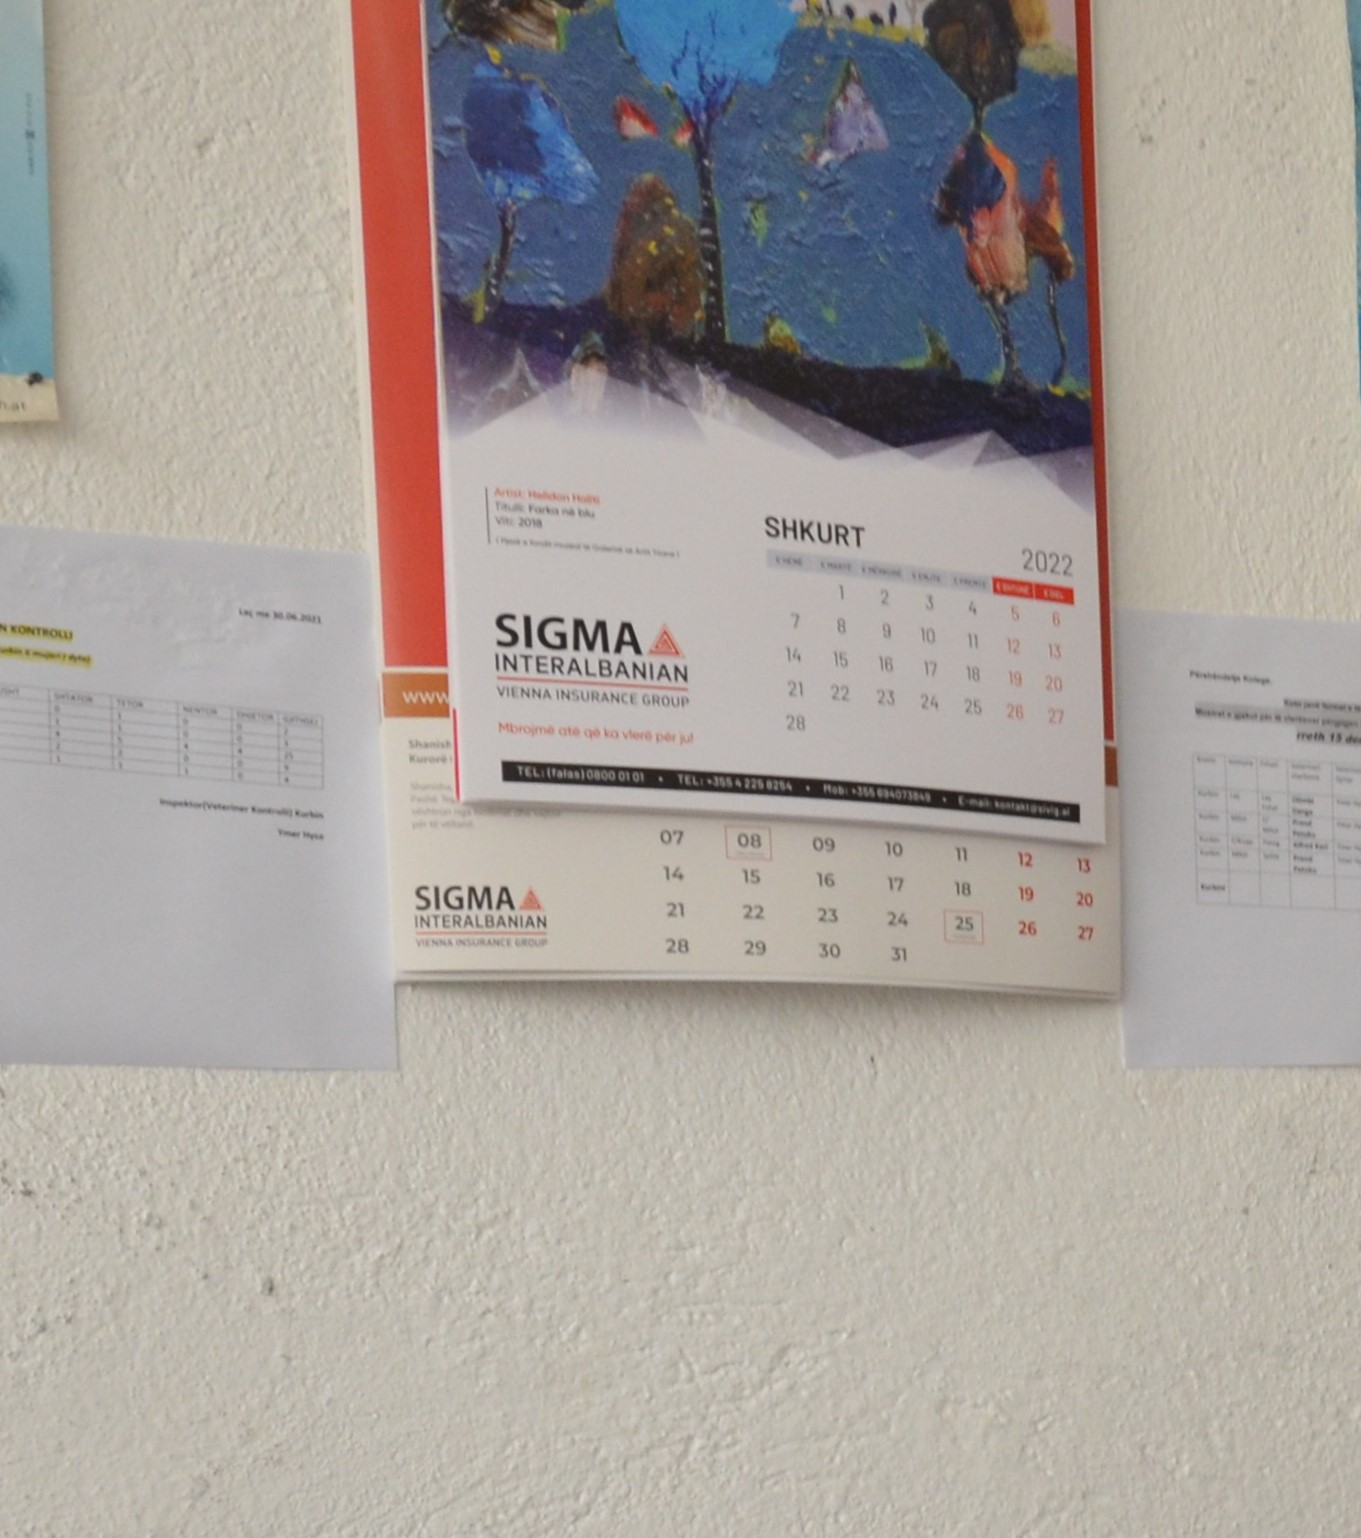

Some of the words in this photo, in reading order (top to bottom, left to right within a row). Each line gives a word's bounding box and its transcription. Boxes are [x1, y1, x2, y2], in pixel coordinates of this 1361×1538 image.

[518, 517, 543, 528] 2018
[765, 516, 865, 548] SHKURT
[1022, 548, 1073, 577] 2022
[495, 613, 643, 656] SIGMA
[495, 653, 688, 683] INTERALBANIAN
[497, 686, 551, 701] VIENNA
[556, 689, 635, 705] INSURANCE
[642, 694, 689, 708] GROUP
[498, 721, 555, 737] Mbrojmë
[558, 726, 581, 737] atë
[584, 728, 601, 740] që
[604, 727, 619, 739] ka
[622, 729, 653, 741] vlerë
[655, 732, 676, 744] për
[1329, 731, 1343, 743] 15
[517, 765, 544, 778] TEL:
[586, 769, 616, 781] 0800
[618, 771, 630, 782] 01
[632, 771, 644, 783] 01
[677, 773, 703, 786] TEL:
[707, 776, 733, 788] +355
[735, 778, 742, 788] 4
[823, 783, 848, 796] Mob:
[660, 829, 684, 845] 07
[737, 833, 762, 848] 08
[812, 837, 835, 852] 09
[885, 841, 903, 857] 10
[955, 847, 968, 862] 11
[1018, 851, 1033, 867] 12
[1077, 857, 1091, 873] 13
[415, 885, 515, 911] SIGMA
[663, 866, 684, 881] 14
[742, 868, 761, 884] 15
[817, 872, 835, 887] 16
[888, 876, 904, 892] 17
[955, 881, 971, 896] 18
[1019, 886, 1034, 902] 19
[1077, 892, 1094, 907] 20
[415, 914, 547, 928] INTERALBANIAN
[667, 902, 685, 917] 21
[743, 904, 764, 920] 22
[818, 907, 838, 923] 23
[888, 911, 908, 927] 24
[955, 916, 974, 931] 25
[1018, 920, 1037, 936] 26
[1078, 925, 1094, 941] 27
[416, 938, 453, 947] VIENNA
[455, 938, 511, 947] INSURANCE
[514, 938, 548, 947] GROUP
[666, 938, 689, 953] 28
[744, 940, 767, 956] 29
[819, 943, 841, 958] 30
[892, 946, 907, 962] 31
